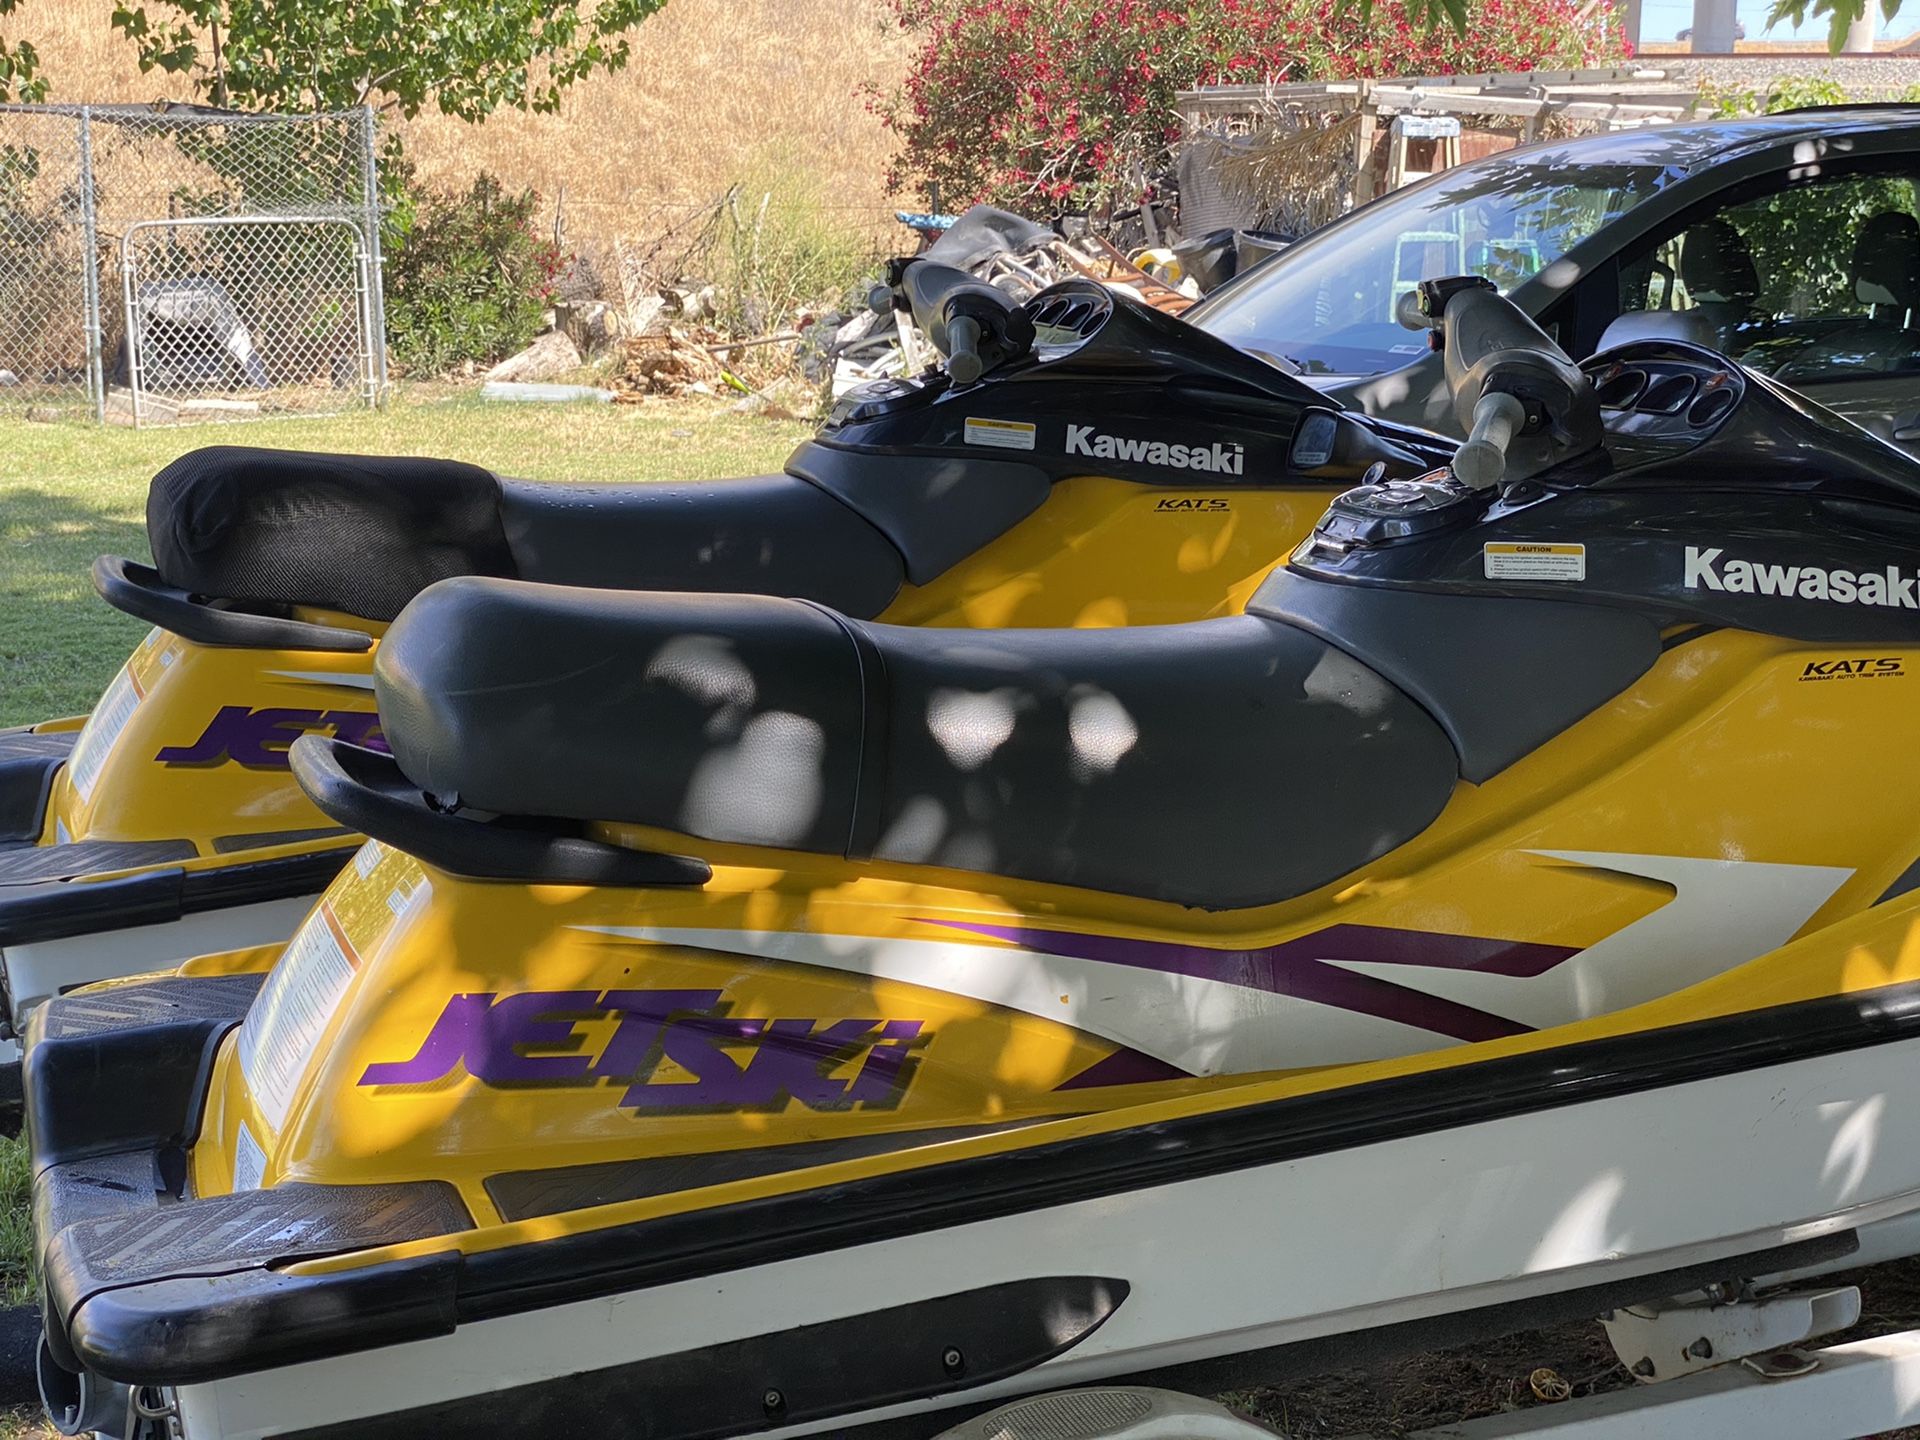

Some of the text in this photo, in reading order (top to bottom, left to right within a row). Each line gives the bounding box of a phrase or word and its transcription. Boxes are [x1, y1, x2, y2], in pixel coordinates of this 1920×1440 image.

[1065, 424, 1244, 475] Kawasaki
[1157, 499, 1229, 509] KATS
[1684, 546, 1920, 610] Kawasak
[1803, 657, 1902, 676] KATS
[356, 988, 727, 1089] JET
